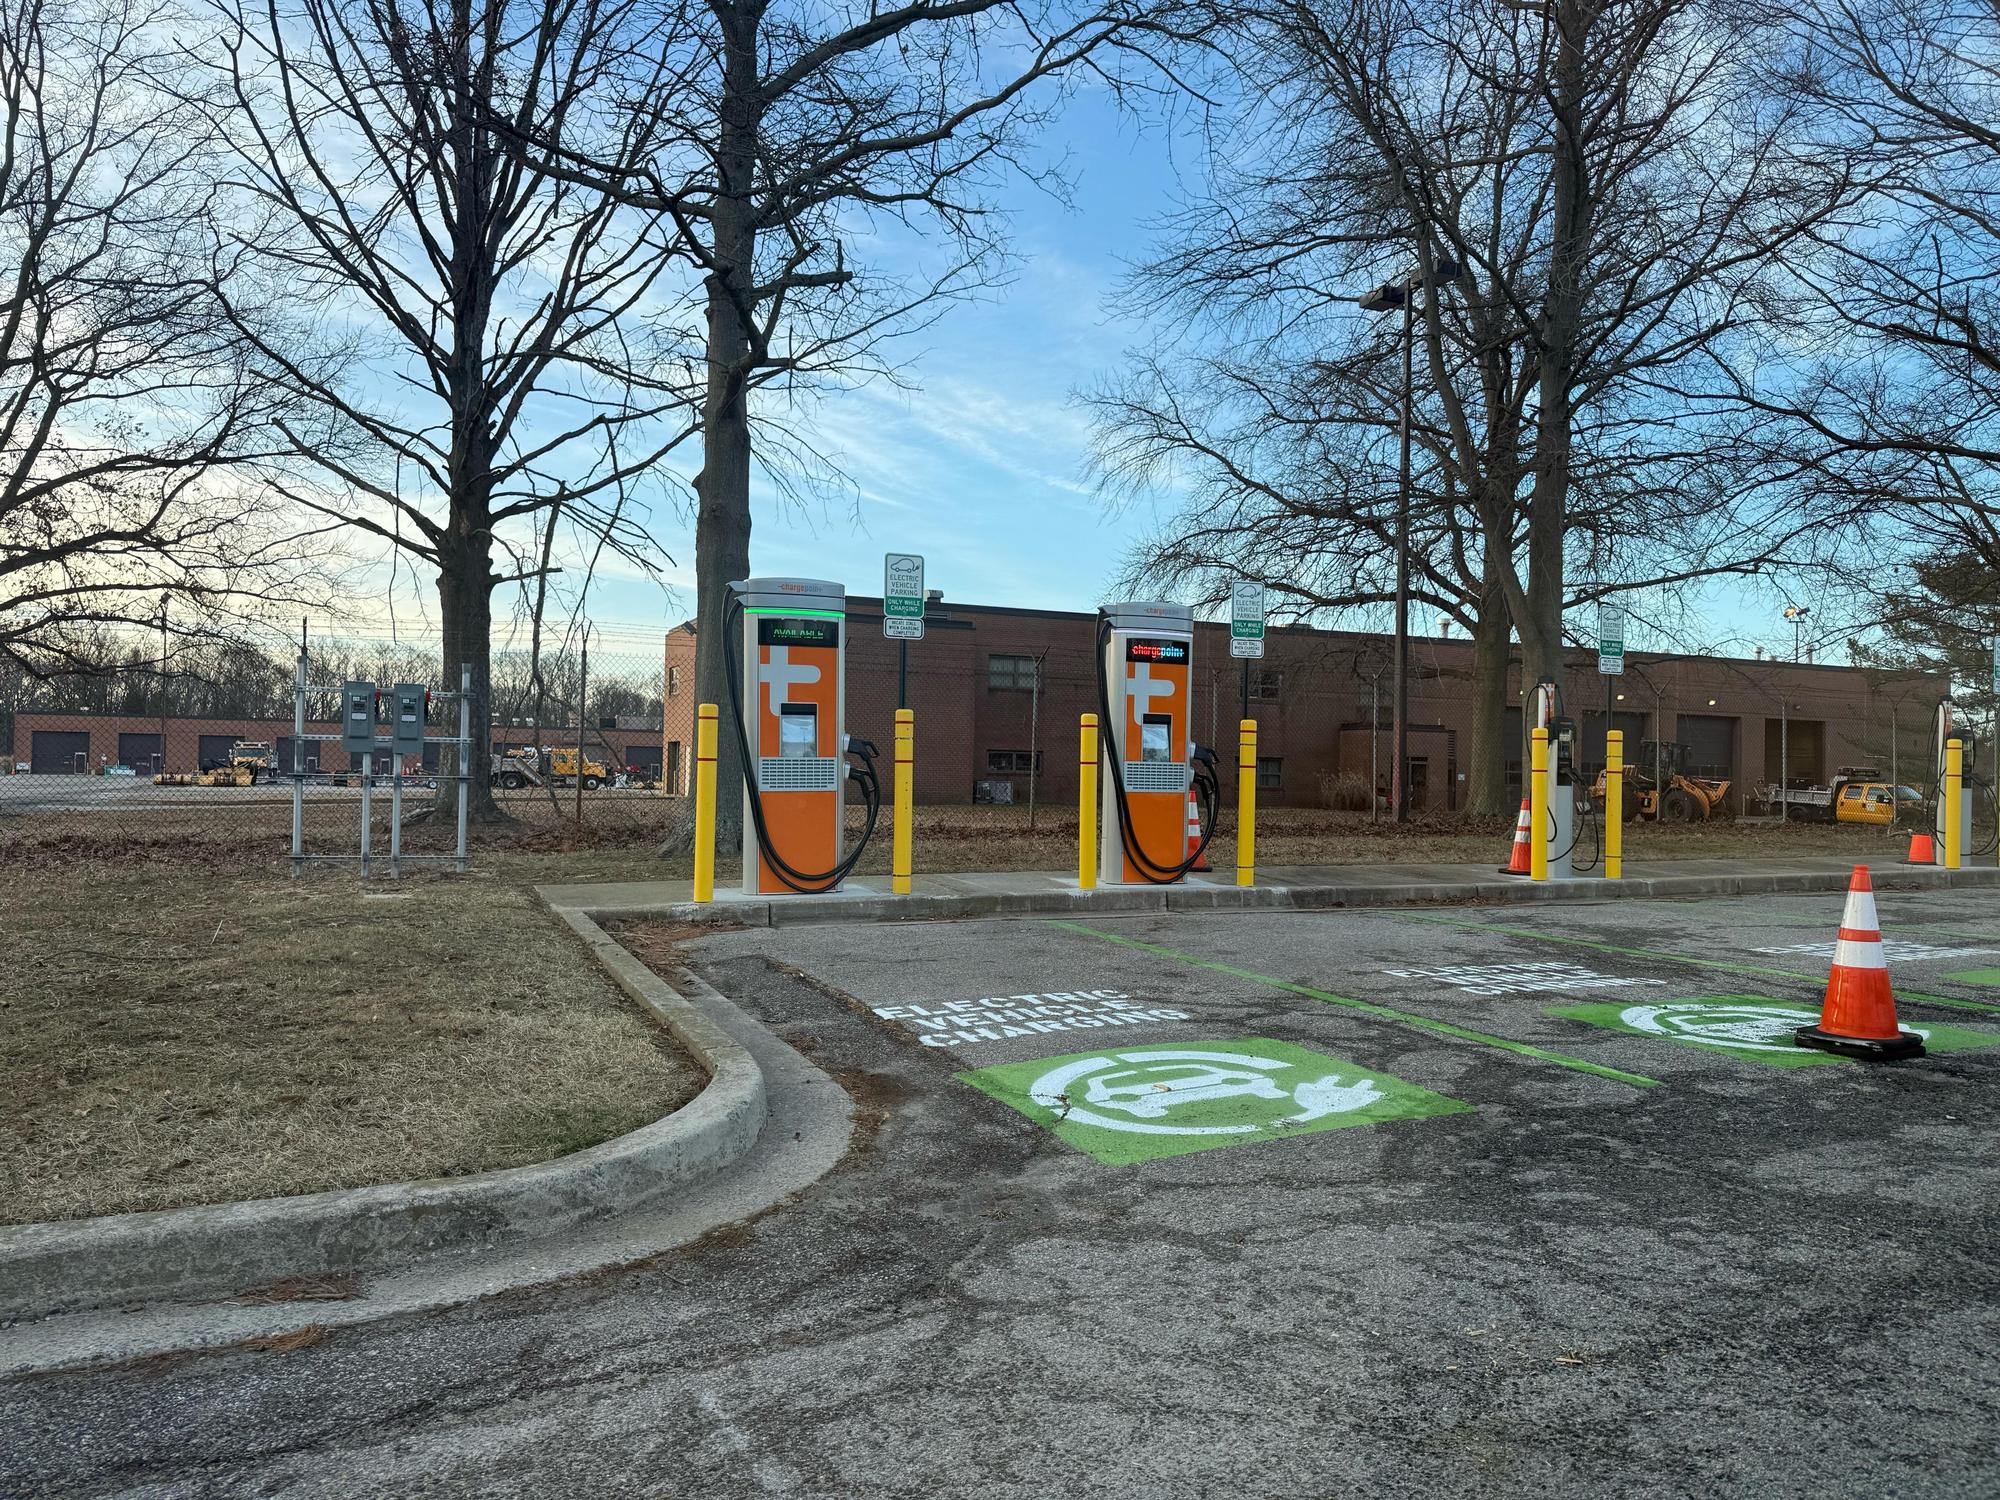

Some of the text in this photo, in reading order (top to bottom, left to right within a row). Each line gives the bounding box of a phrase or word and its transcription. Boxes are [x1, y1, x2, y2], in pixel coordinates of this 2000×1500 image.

[1132, 644, 1184, 658] chargepoint
[1381, 962, 1585, 978] ELECTRIC
[1460, 977, 1668, 995] CHARGING
[872, 989, 1130, 1020] ELECTRIC
[912, 1000, 1144, 1030] VEHICLE
[919, 1008, 1192, 1048] CHARGING
